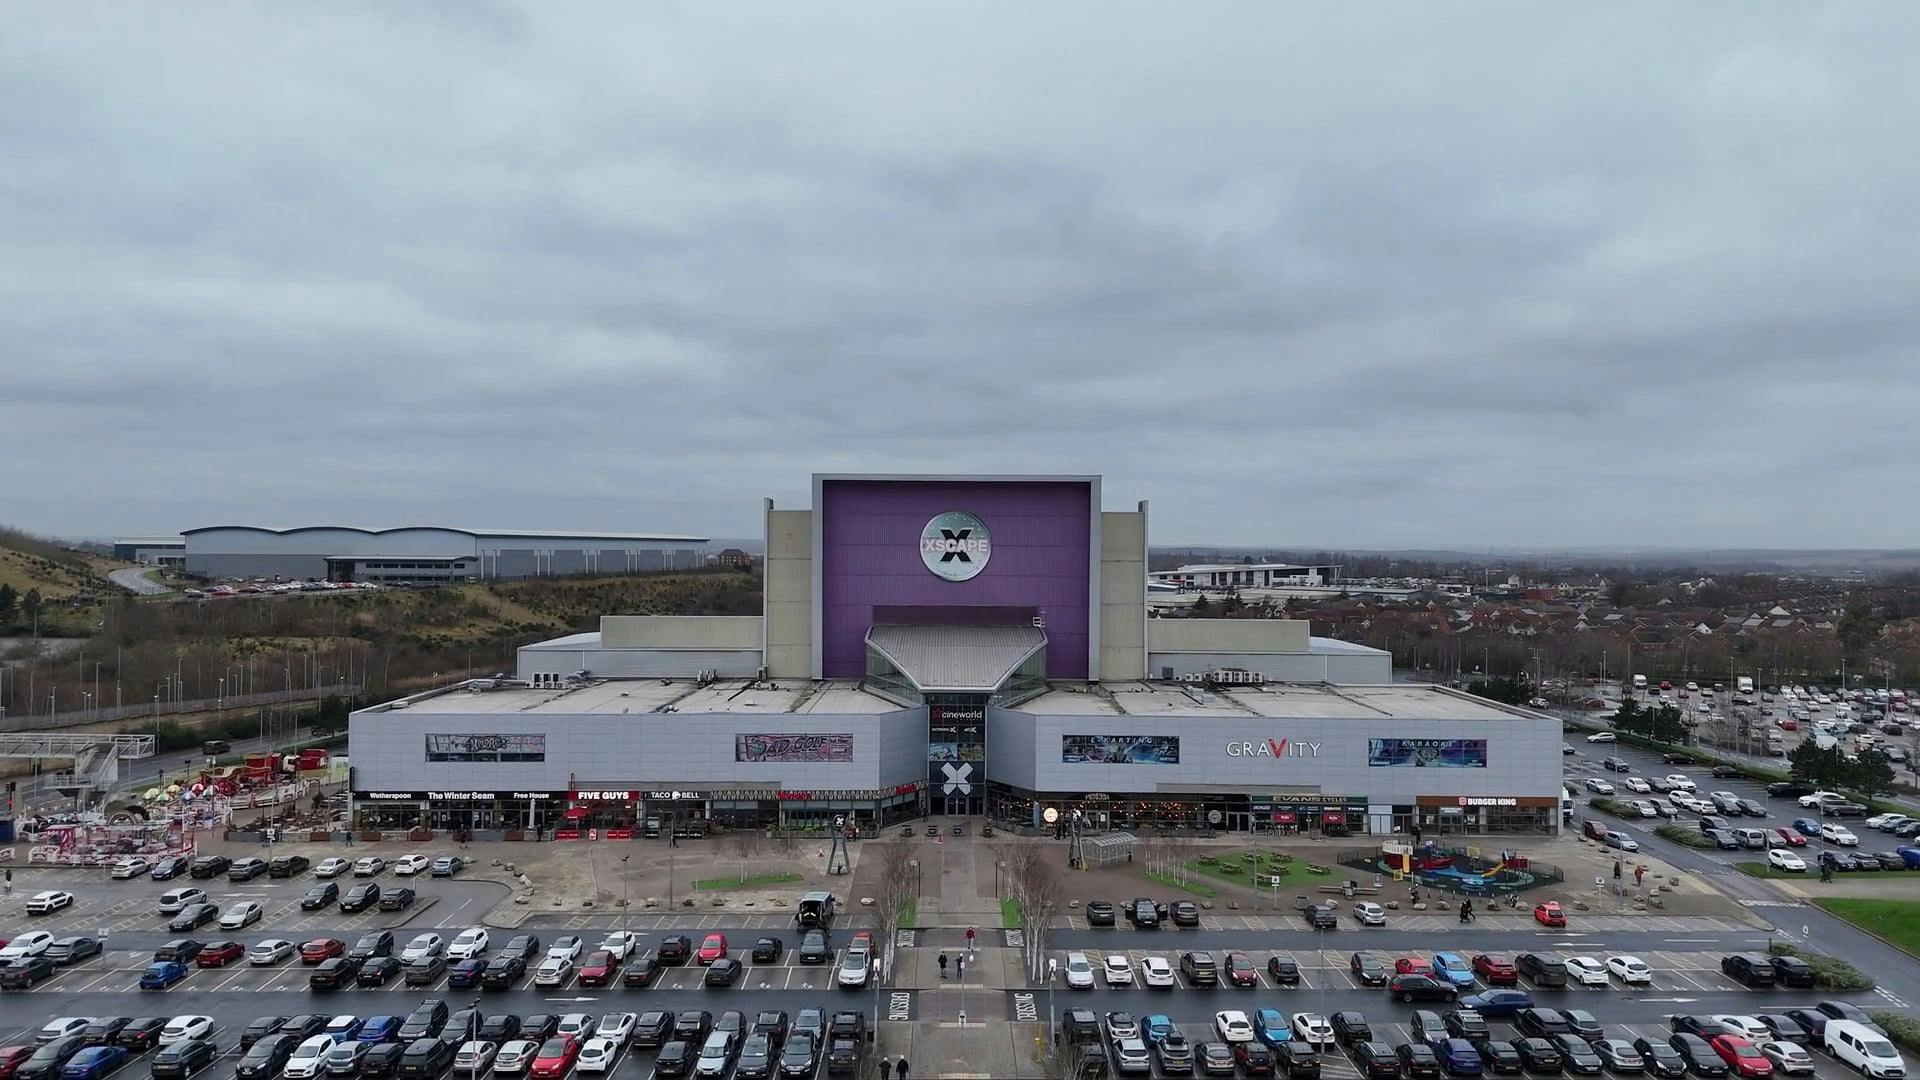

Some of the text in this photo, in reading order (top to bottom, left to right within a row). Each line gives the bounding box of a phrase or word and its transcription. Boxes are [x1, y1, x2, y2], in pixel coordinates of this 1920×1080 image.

[924, 539, 988, 553] XSCAPE
[941, 710, 982, 719] cineworld
[1226, 737, 1321, 758] GRAVITY
[369, 792, 412, 800] Wetherspoon
[428, 791, 495, 800] The Winter Seam
[578, 791, 630, 800] FIVE GUYS
[650, 791, 700, 799] TACO BELL
[1467, 798, 1517, 806] BURGER KING
